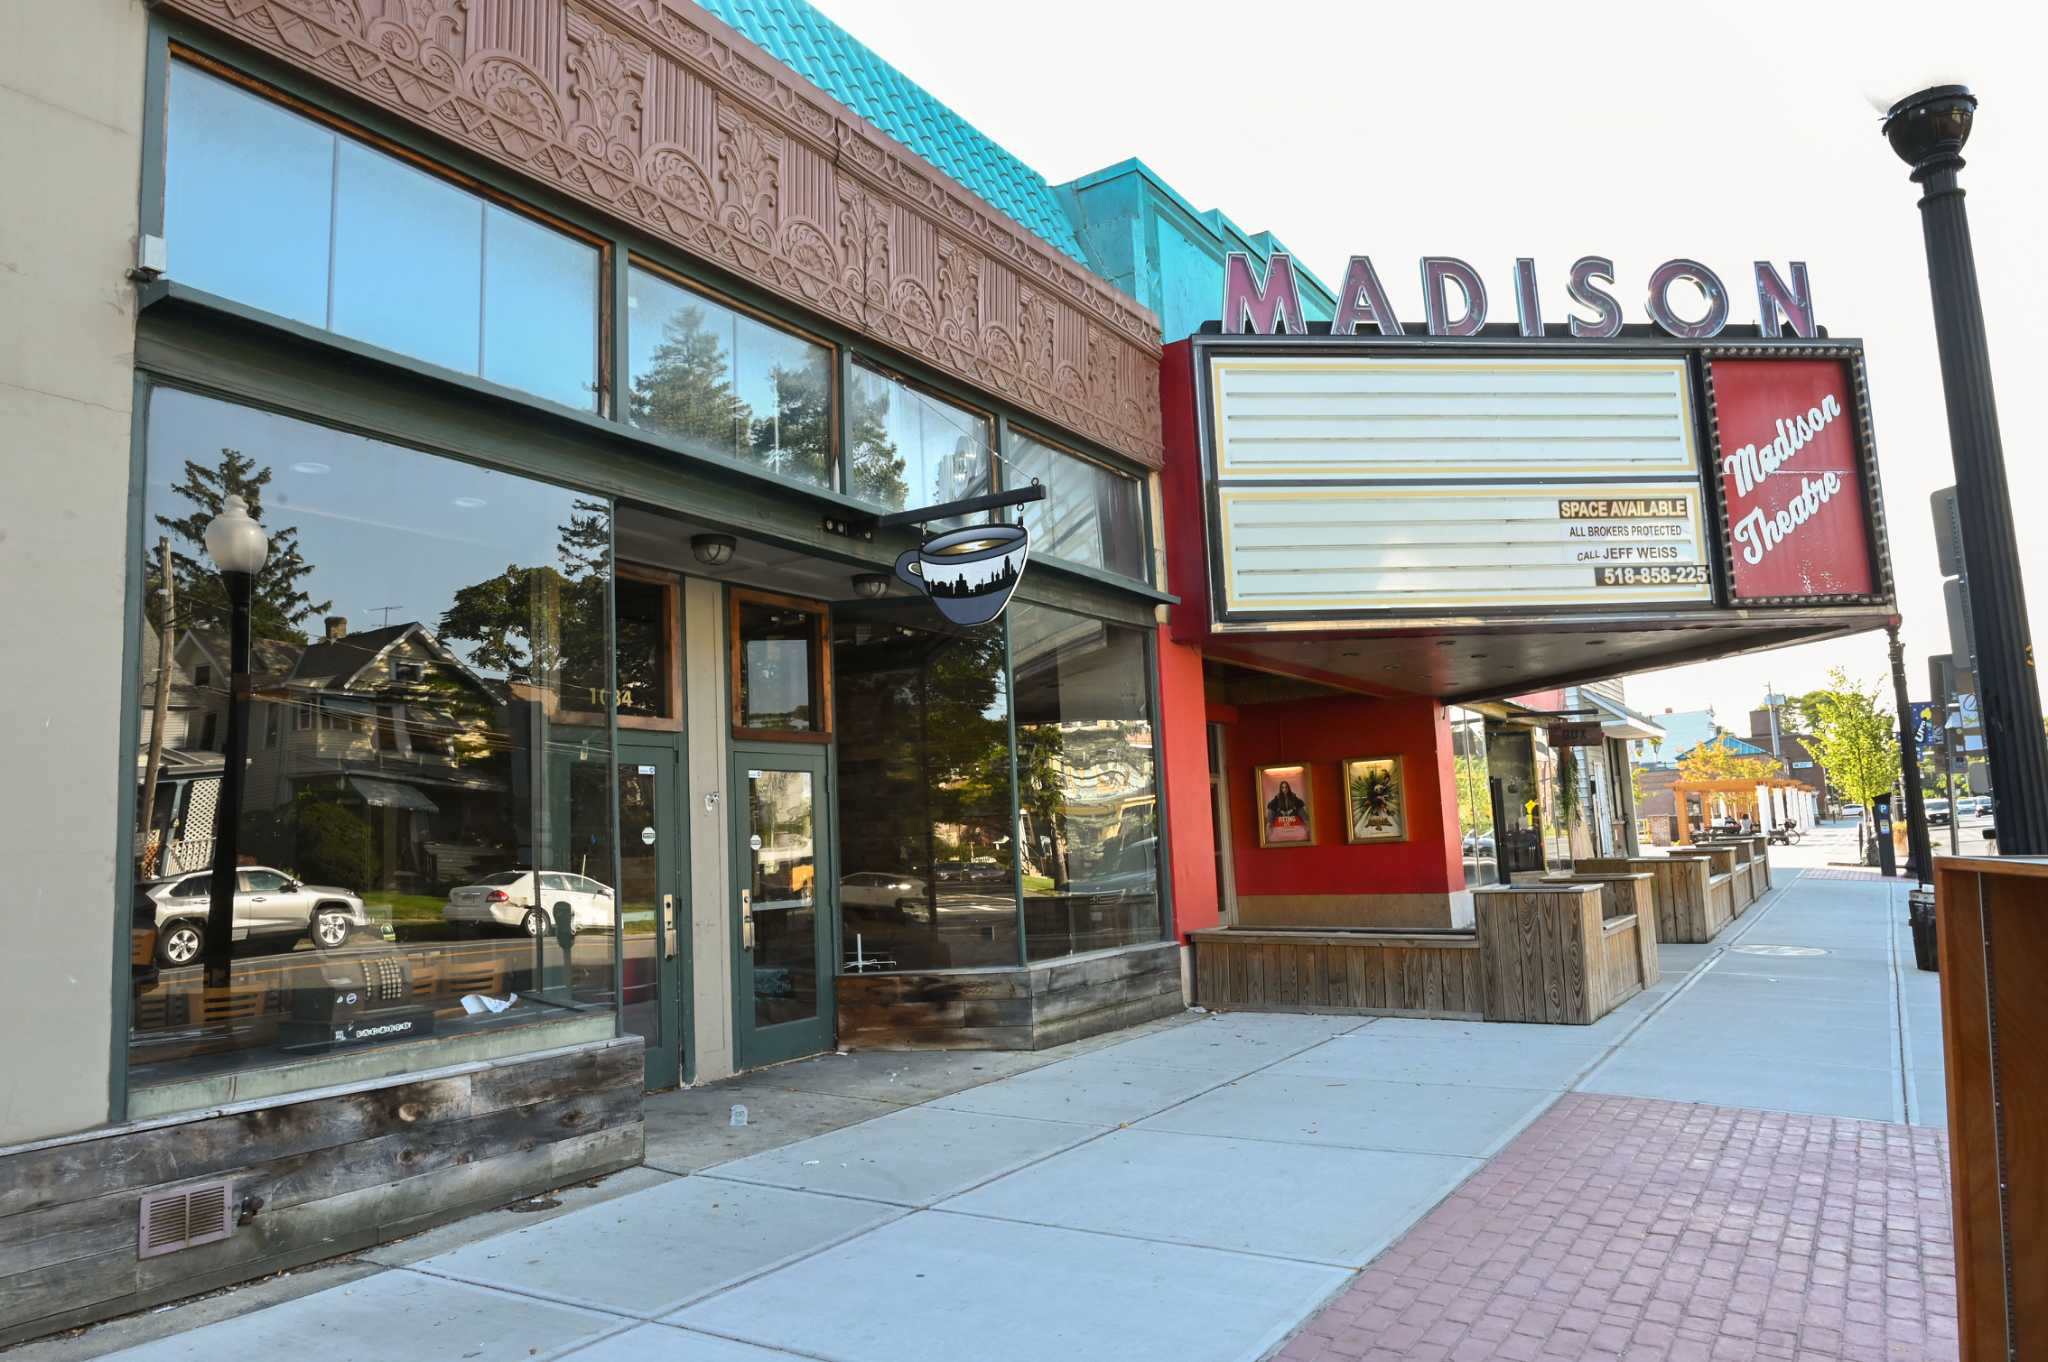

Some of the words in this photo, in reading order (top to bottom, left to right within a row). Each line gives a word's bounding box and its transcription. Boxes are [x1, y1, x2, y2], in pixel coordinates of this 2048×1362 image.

[1221, 252, 1817, 337] MADISON
[1723, 394, 1841, 497] Madison
[1561, 501, 1608, 518] SPACE
[1610, 500, 1686, 517] AVAILABLE
[1733, 471, 1841, 565] Theatre
[1569, 526, 1586, 537] ALL
[1587, 526, 1630, 537] BROKERS
[1631, 524, 1682, 537] PROTECTED
[1577, 549, 1600, 562] CALL
[1602, 547, 1633, 560] JEFF
[1636, 546, 1678, 559] WEISS
[1604, 566, 1710, 585] 518-858-225
